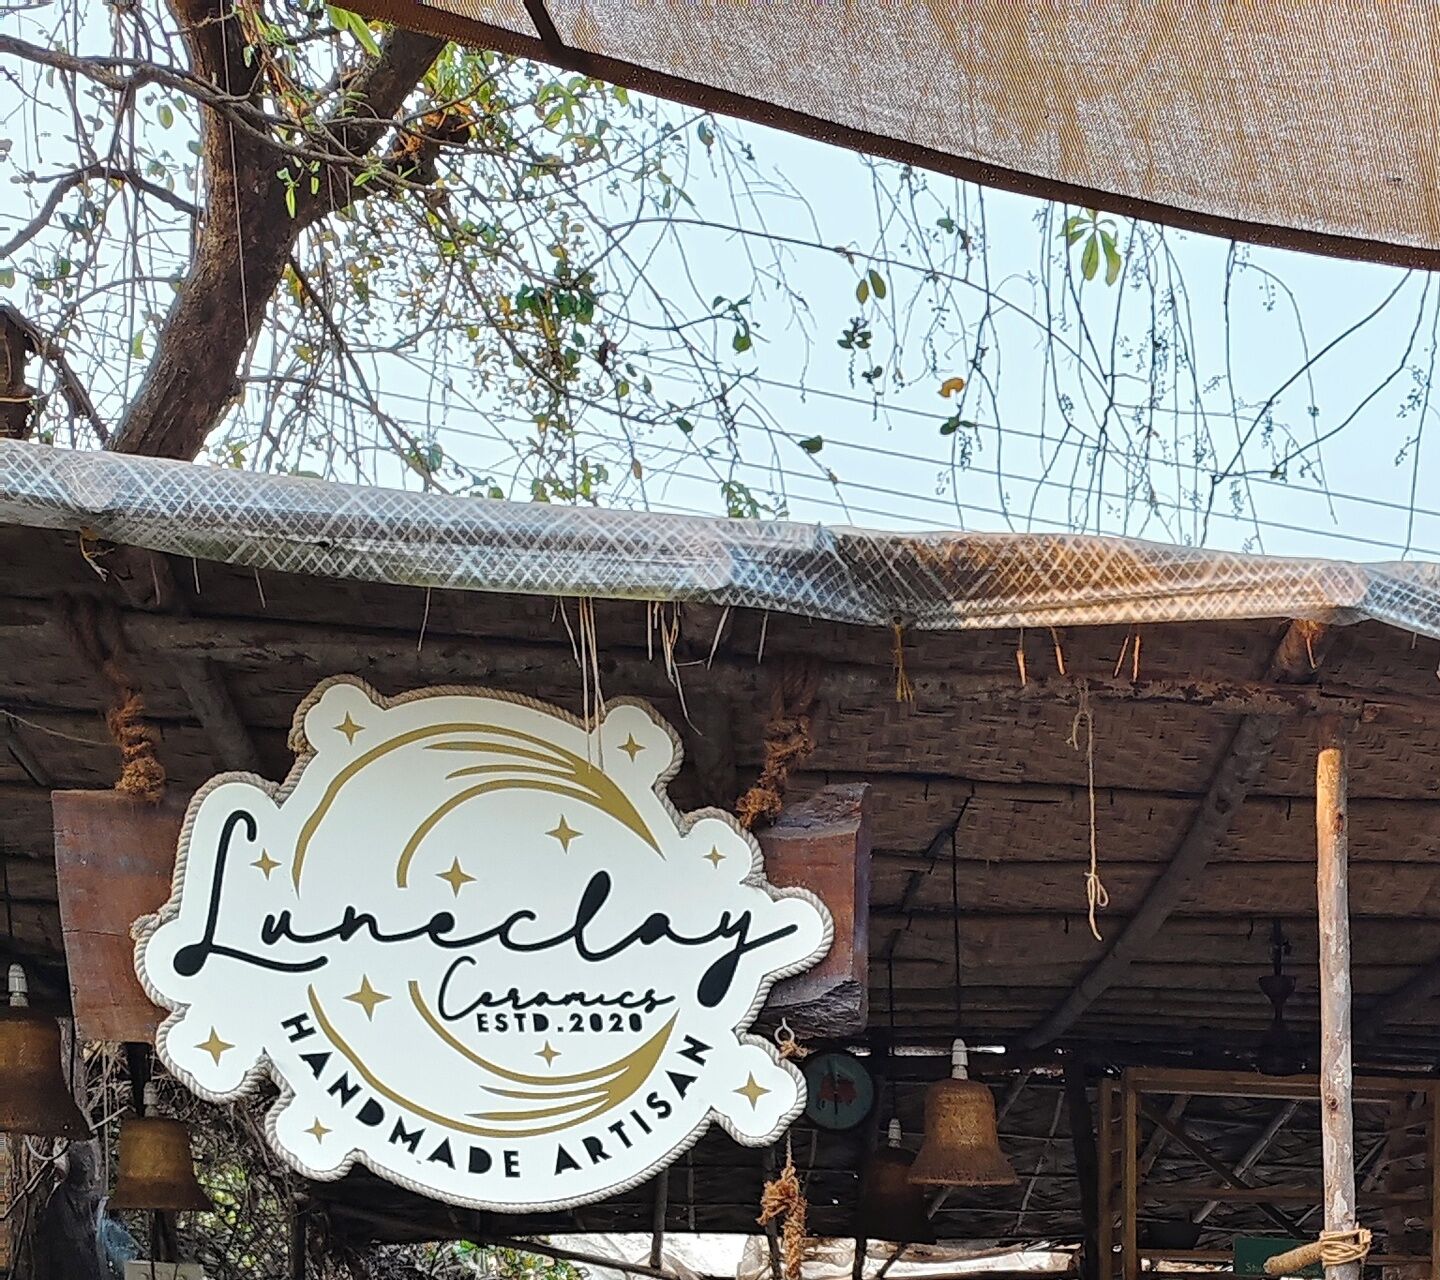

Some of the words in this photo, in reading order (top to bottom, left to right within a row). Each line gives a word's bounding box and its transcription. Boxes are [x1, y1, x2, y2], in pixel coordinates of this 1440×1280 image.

[172, 810, 799, 1008] Luneclay
[438, 955, 676, 1022] Ceramics
[477, 1013, 643, 1033] ESTD.2020
[281, 1012, 520, 1178] HANDMADE
[554, 1034, 713, 1176] ARTISAN
